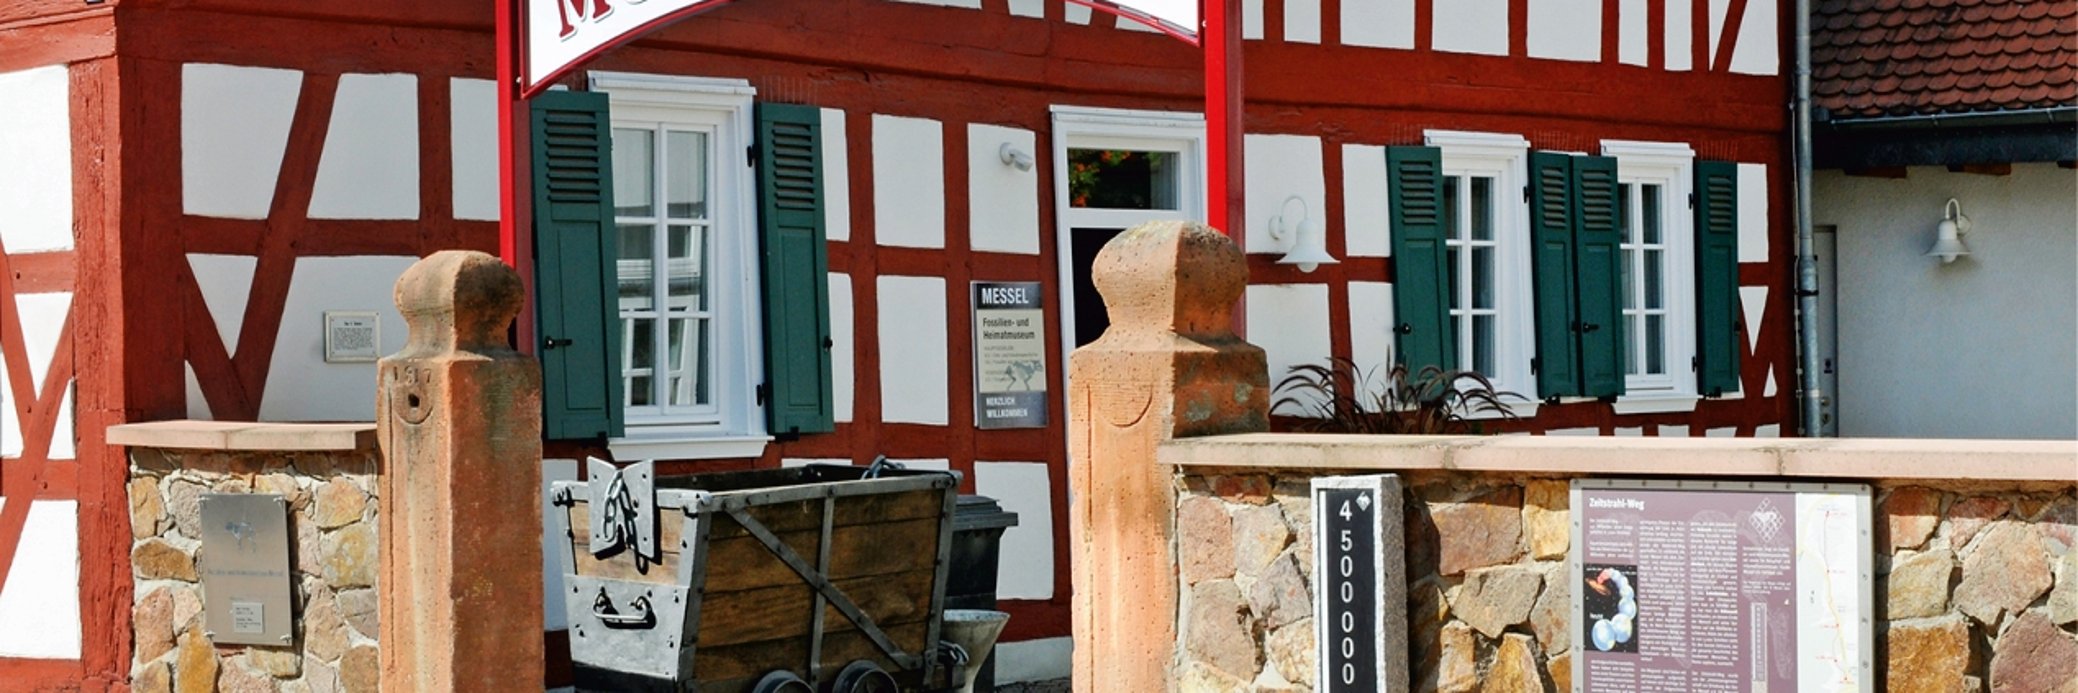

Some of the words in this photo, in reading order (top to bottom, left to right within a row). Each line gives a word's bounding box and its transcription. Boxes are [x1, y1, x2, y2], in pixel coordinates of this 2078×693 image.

[981, 287, 1030, 304] MESSEL
[982, 317, 1015, 327] Fossilien-
[1016, 317, 1030, 327] und
[983, 330, 1035, 340] Heimatmuseum
[1588, 497, 1645, 511] Zeitstrahl-Weg
